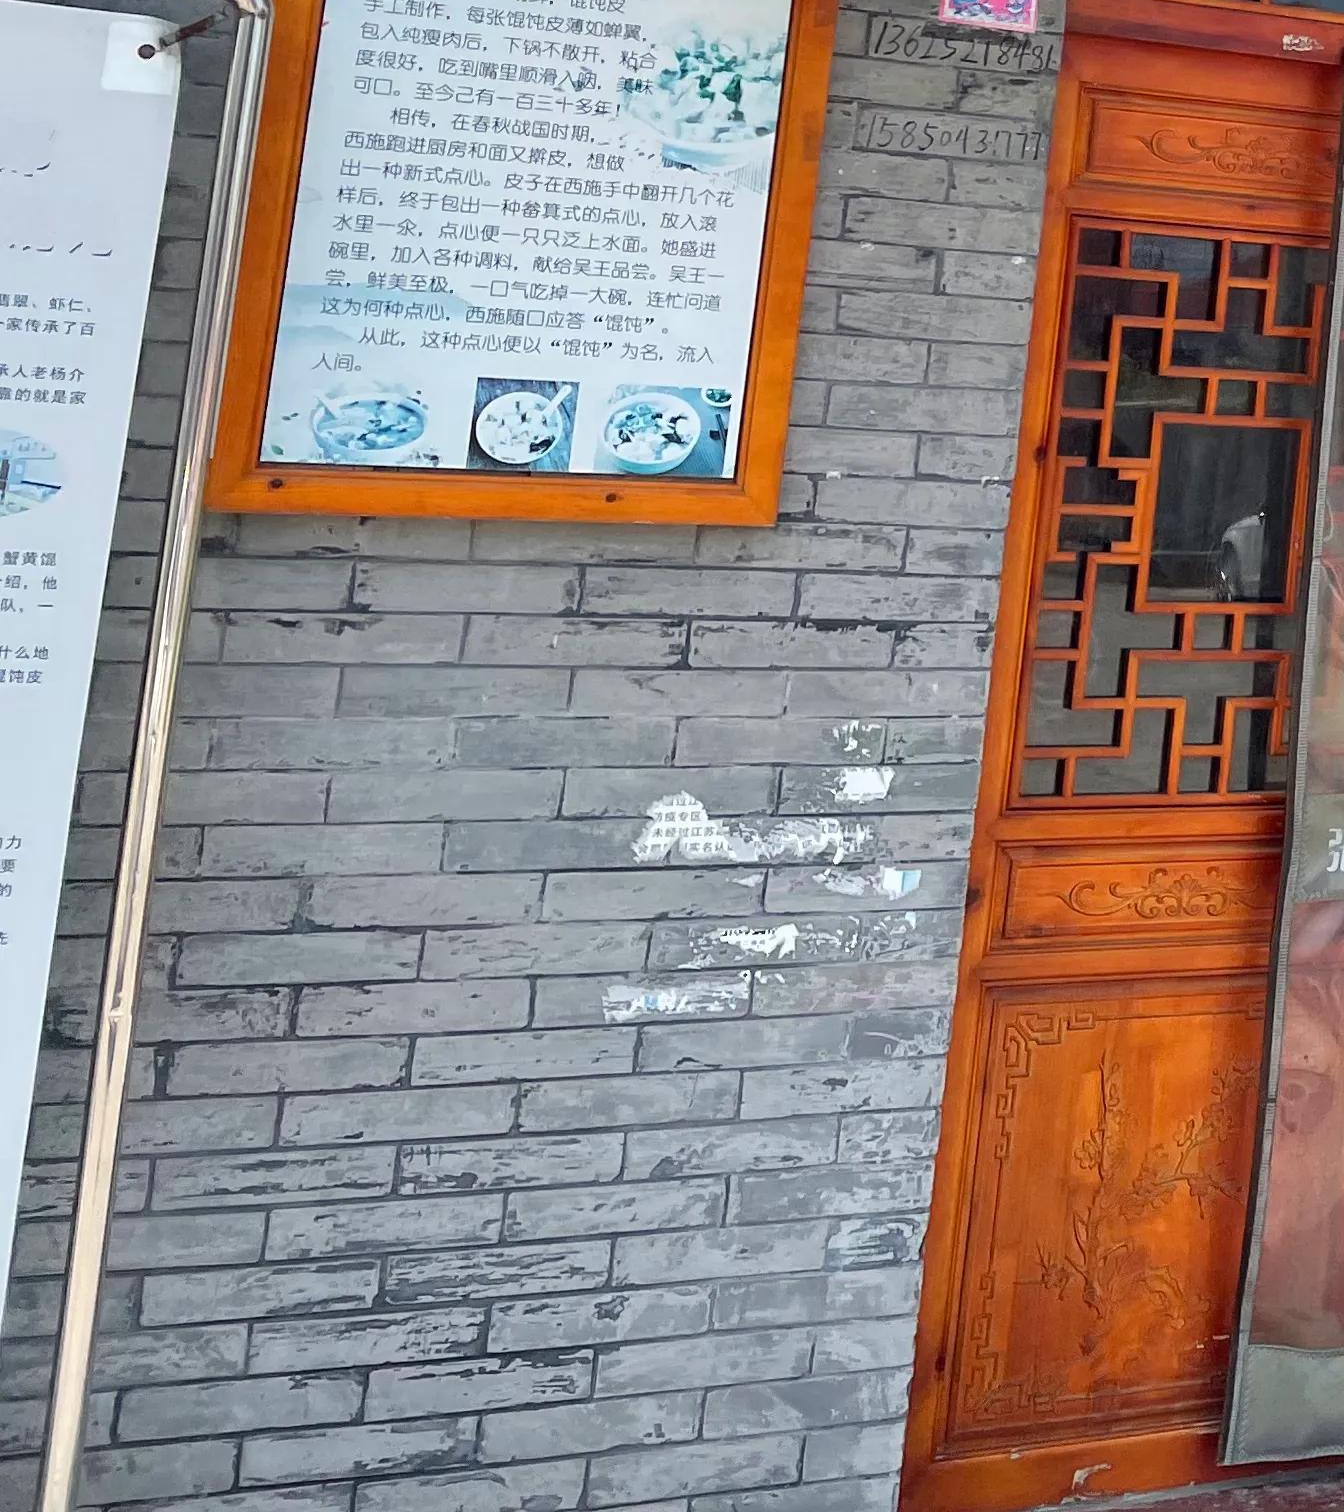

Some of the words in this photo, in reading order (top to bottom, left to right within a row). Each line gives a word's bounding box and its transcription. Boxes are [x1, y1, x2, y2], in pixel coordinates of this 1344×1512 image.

[0, 317, 95, 336] 家传承了百
[311, 351, 365, 374] 人间。
[0, 575, 57, 590] 绍，他
